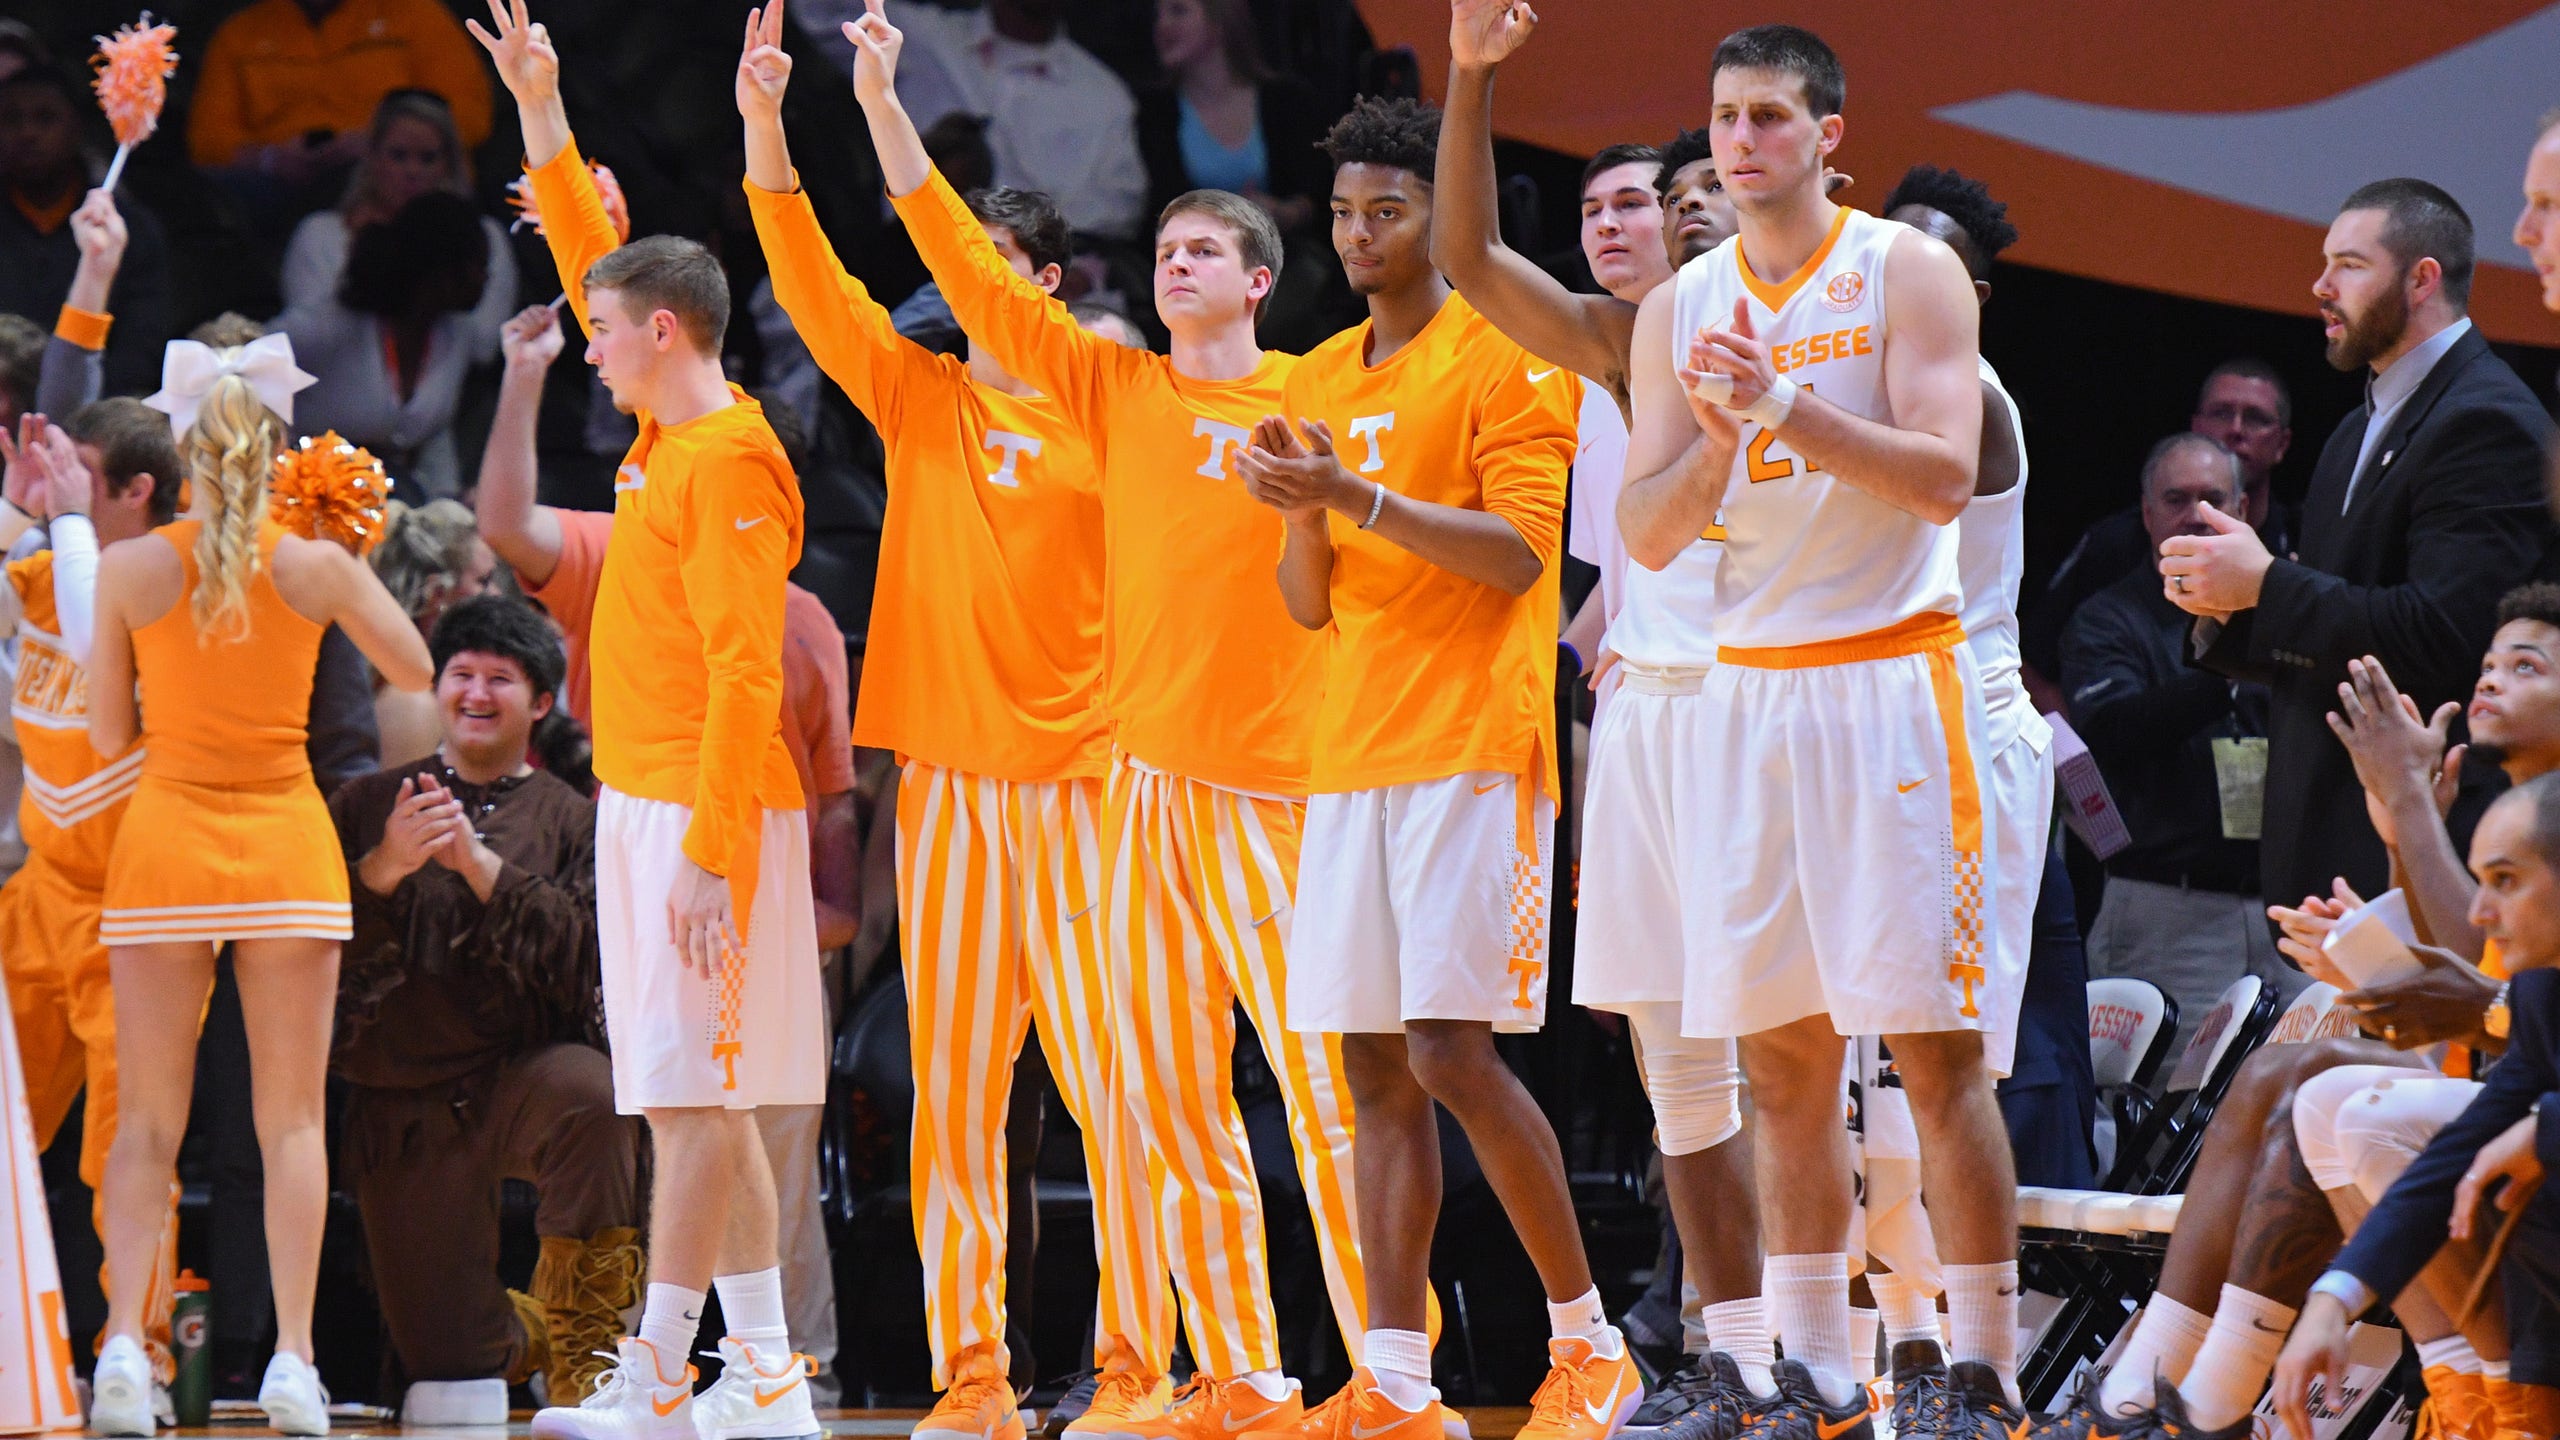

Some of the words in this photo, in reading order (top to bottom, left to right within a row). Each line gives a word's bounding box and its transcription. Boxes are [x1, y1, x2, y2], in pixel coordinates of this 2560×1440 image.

[1829, 273, 1861, 300] SEC
[983, 429, 1042, 488] T
[1193, 416, 1251, 481] T
[1348, 411, 1395, 472] T
[1507, 957, 1542, 1010] T
[1948, 963, 1985, 1018] T
[711, 1041, 743, 1091] T
